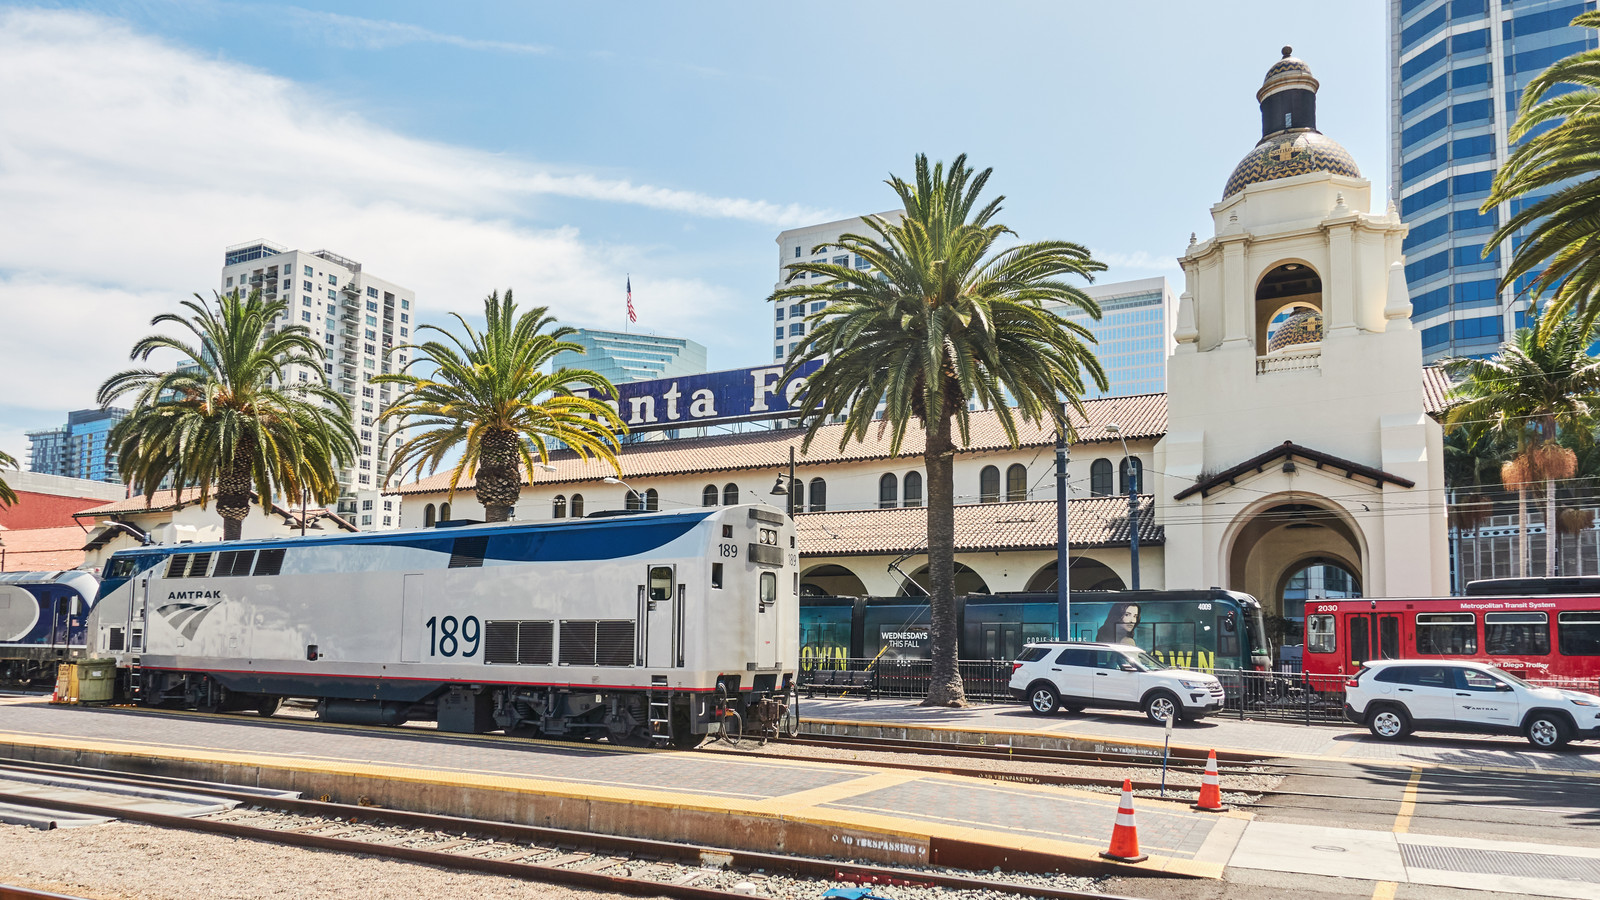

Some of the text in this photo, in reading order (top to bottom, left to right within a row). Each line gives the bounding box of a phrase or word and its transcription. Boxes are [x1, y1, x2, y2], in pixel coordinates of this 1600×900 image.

[750, 366, 811, 412] Fe
[718, 543, 738, 558] 189
[167, 590, 221, 600] AMTRAK
[1197, 603, 1212, 611] 4009
[1318, 604, 1338, 612] 2030
[425, 615, 481, 658] 189
[881, 632, 928, 640] WEDNESDAYS
[889, 640, 920, 648] THIS FALL
[1502, 661, 1524, 669] Diego
[1525, 661, 1549, 669] Trolley
[841, 835, 916, 855] NO TRESPASSING
